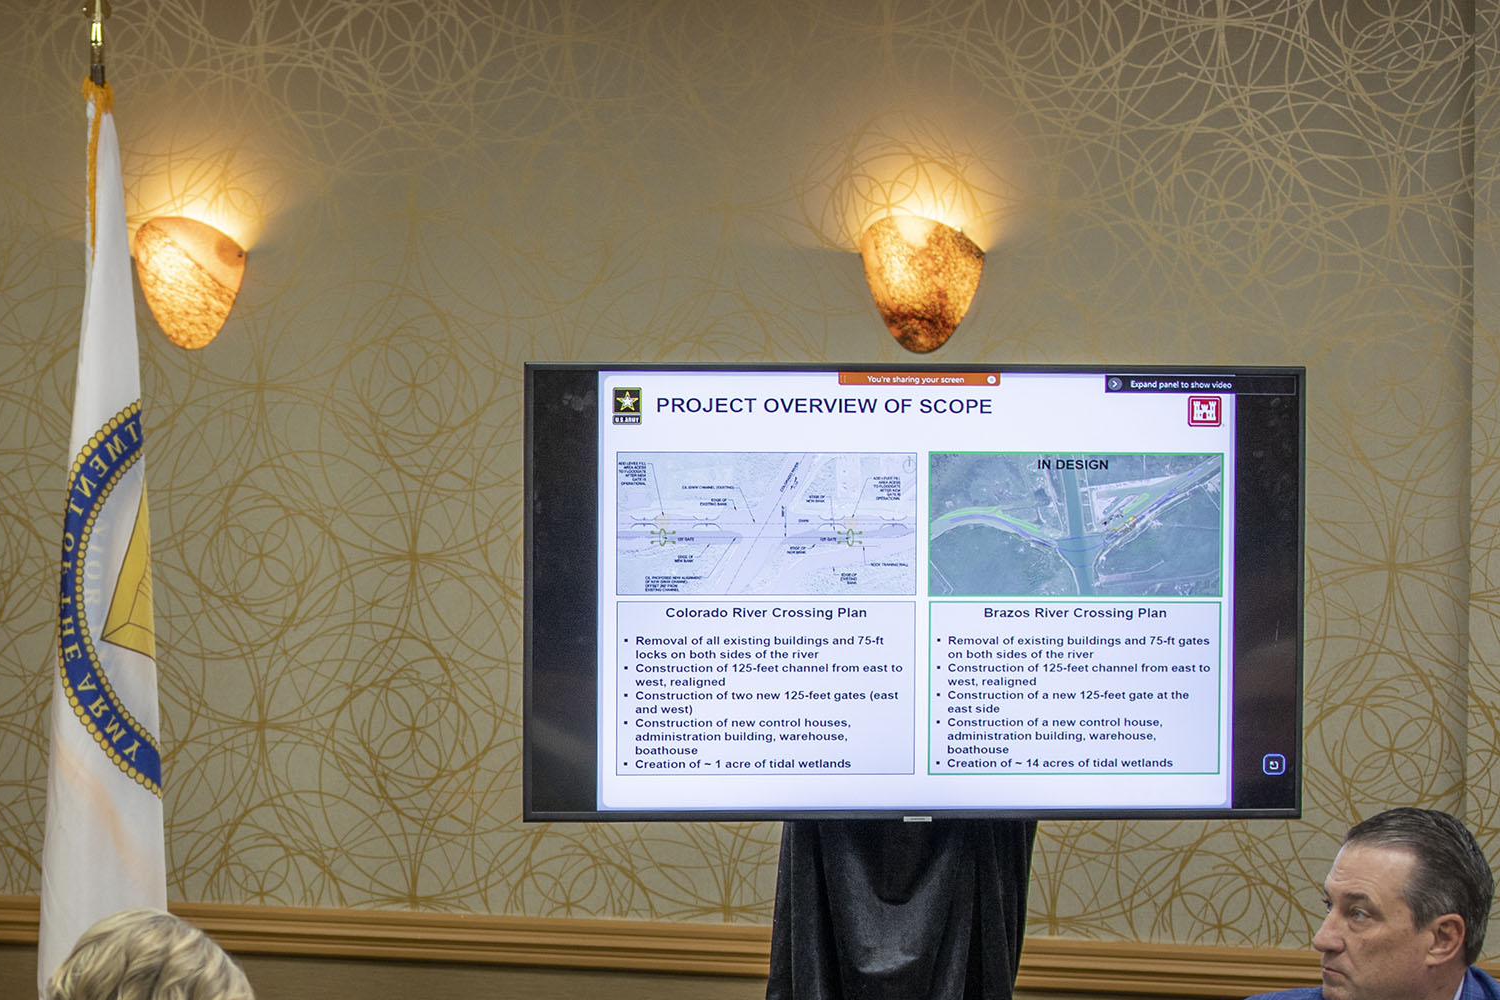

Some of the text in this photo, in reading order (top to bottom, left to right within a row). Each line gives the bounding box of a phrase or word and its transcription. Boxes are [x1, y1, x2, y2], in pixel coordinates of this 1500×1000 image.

[892, 376, 920, 384] sharing
[1131, 380, 1157, 389] Expand
[1159, 381, 1179, 389] panel
[1212, 381, 1232, 389] video
[657, 398, 992, 414] PROJECT OVERVIEW OF SCOPE
[1038, 460, 1108, 470] IN DESIGN
[666, 608, 867, 620] Colorado River Crossing Plan
[984, 608, 1167, 621] Brazos River Crossing Plan
[636, 636, 883, 647] Removal of all existing buildings and 75-ft
[948, 636, 1210, 647] Removal of existing buildings and 75-ft gates
[636, 650, 667, 659] locks
[690, 650, 716, 659] both
[720, 650, 751, 659] sides
[755, 650, 767, 659] of
[770, 650, 788, 659] the
[792, 650, 819, 659] river
[967, 650, 992, 659] both
[996, 650, 1027, 659] sides
[1031, 650, 1042, 659] of
[1046, 650, 1064, 659] the
[1068, 650, 1094, 659] river
[636, 664, 713, 673] Construction
[716, 664, 728, 672] of
[732, 663, 778, 672] 125-feet
[782, 663, 828, 672] channel
[832, 663, 859, 672] from
[948, 663, 1024, 672] Construction
[1028, 663, 1039, 672] of
[1043, 663, 1088, 672] 125-feet
[1092, 663, 1137, 672] channel
[1141, 663, 1168, 672] from
[1199, 664, 1211, 672] to
[635, 677, 725, 688] west, realigned
[948, 677, 1036, 688] west, realigned
[636, 691, 713, 700] Construction
[716, 691, 728, 700] of
[732, 692, 753, 700] two
[785, 691, 831, 700] 125-feet
[834, 692, 866, 702] gates
[870, 691, 898, 701] (east
[948, 690, 1024, 699] Construction
[1027, 690, 1039, 699] of
[1080, 690, 1126, 699] 125-feet
[1129, 692, 1154, 701] gate
[1171, 690, 1189, 699] the
[635, 705, 693, 715] and west)
[947, 704, 1000, 713] east side
[635, 718, 712, 728] Construction
[716, 718, 728, 727] of
[759, 718, 800, 727] control
[805, 718, 851, 728] houses,
[948, 718, 1023, 727] Construction
[1027, 718, 1038, 727] of
[1079, 718, 1120, 727] control
[1124, 718, 1162, 727] house,
[635, 732, 847, 743] administration building, warehouse,
[947, 731, 1156, 742] administration building, warehouse,
[635, 746, 698, 755] boathouse
[947, 745, 1009, 754] boathouse
[635, 759, 685, 769] Creation
[689, 759, 701, 768] of
[716, 760, 720, 768] 1
[754, 759, 766, 768] of
[769, 759, 794, 768] tidal
[798, 759, 851, 768] wetlands
[947, 759, 997, 768] Creation
[1000, 759, 1012, 767] of
[1026, 759, 1039, 767] 14
[1078, 758, 1090, 767] of
[1093, 758, 1117, 767] tidal
[1121, 758, 1173, 767] wetlands
